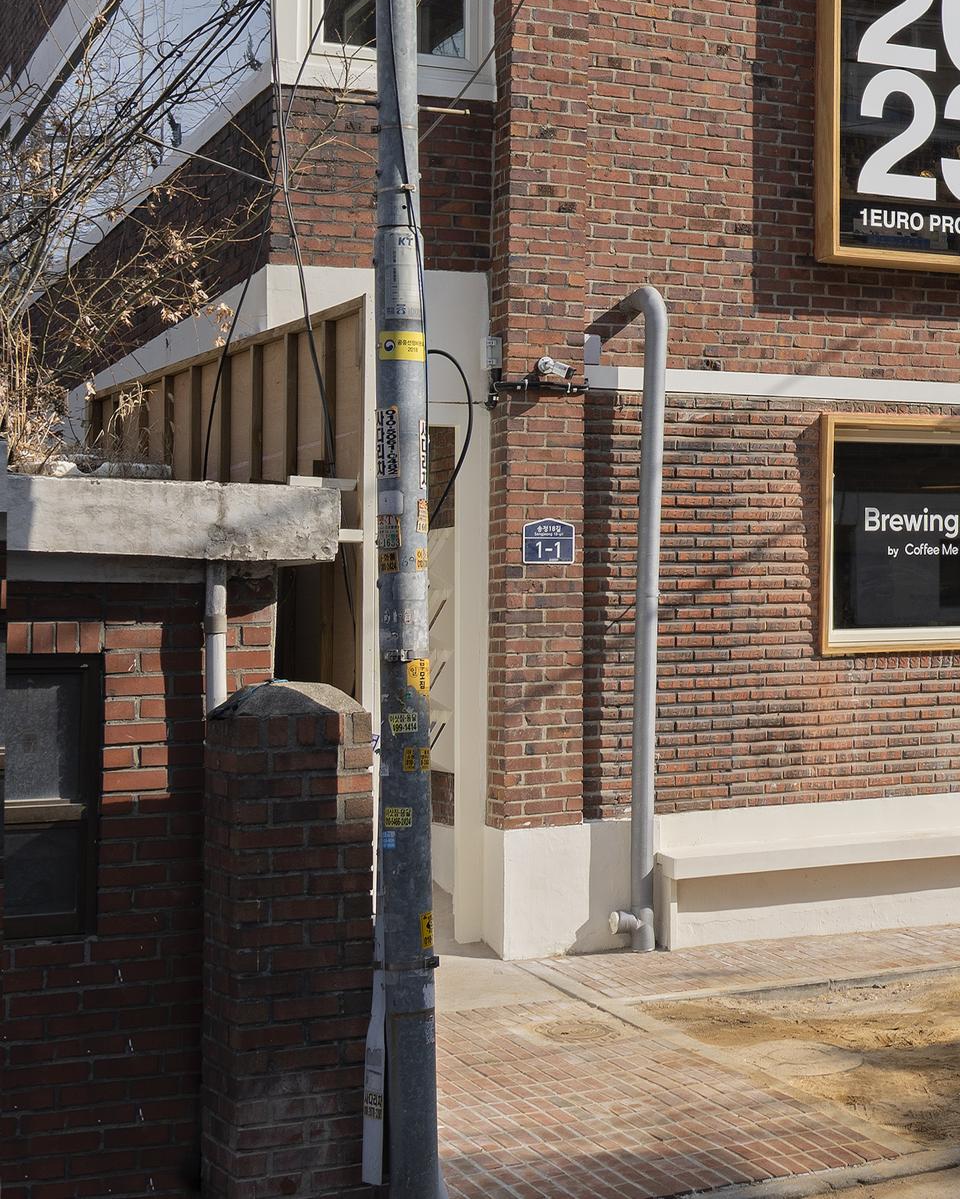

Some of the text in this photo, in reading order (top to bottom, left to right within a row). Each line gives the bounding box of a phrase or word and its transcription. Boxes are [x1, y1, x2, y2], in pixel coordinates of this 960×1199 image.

[860, 208, 924, 232] 1EURO
[864, 507, 959, 538] Brewing
[535, 541, 561, 559] 1-1
[887, 545, 899, 558] by
[904, 543, 940, 556] Coffee
[941, 544, 959, 556] Me
